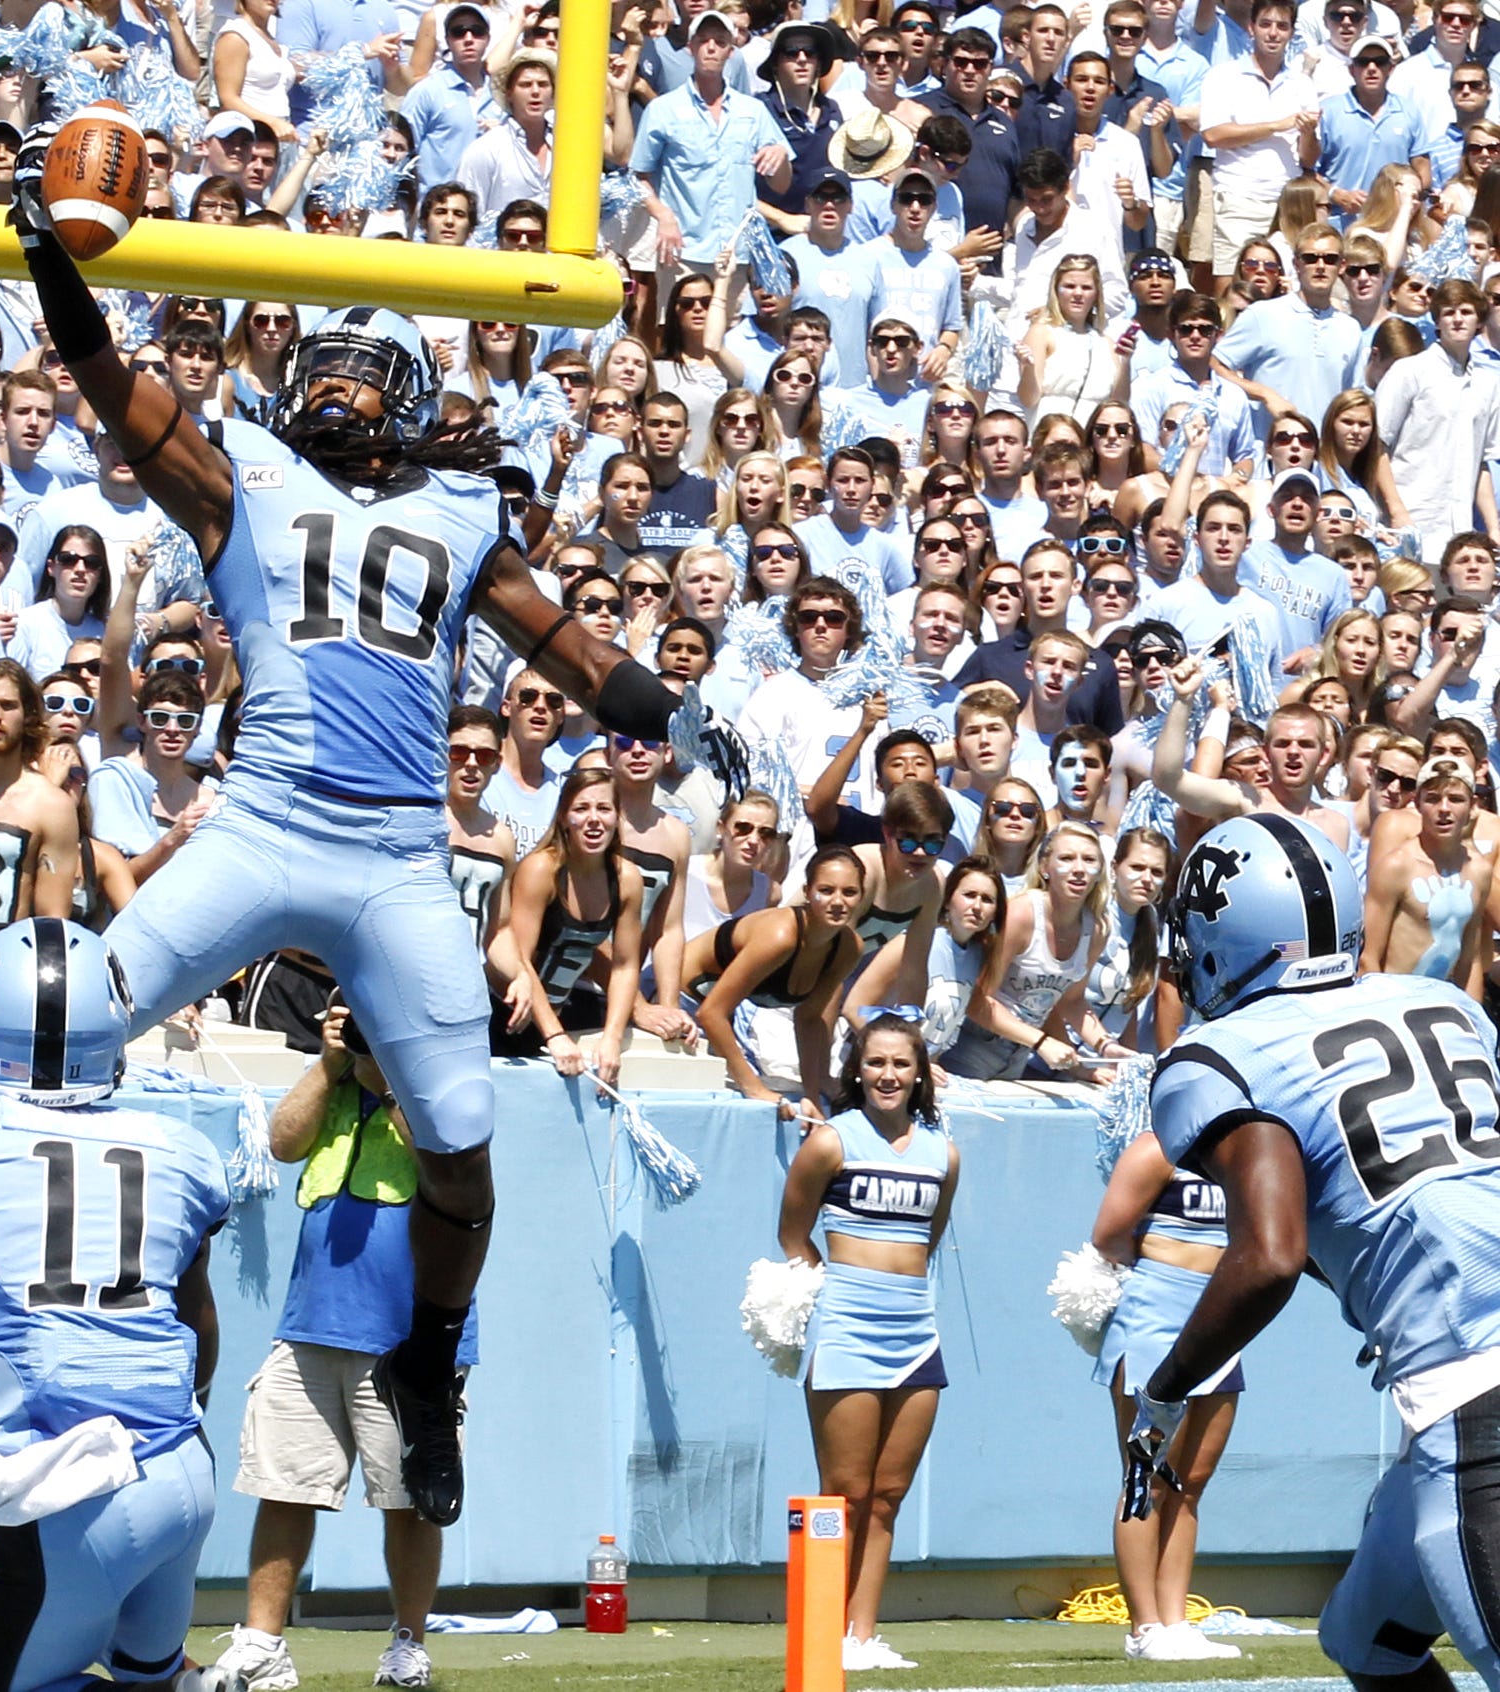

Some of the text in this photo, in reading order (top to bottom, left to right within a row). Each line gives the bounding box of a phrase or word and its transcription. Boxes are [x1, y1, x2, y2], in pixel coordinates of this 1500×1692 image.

[76, 128, 98, 181] Wilson
[244, 470, 280, 483] ACC
[286, 508, 453, 665] 10
[1341, 931, 1358, 951] 26
[68, 1064, 82, 1079] 11
[1311, 1004, 1500, 1208] 26
[23, 1140, 156, 1312] 11
